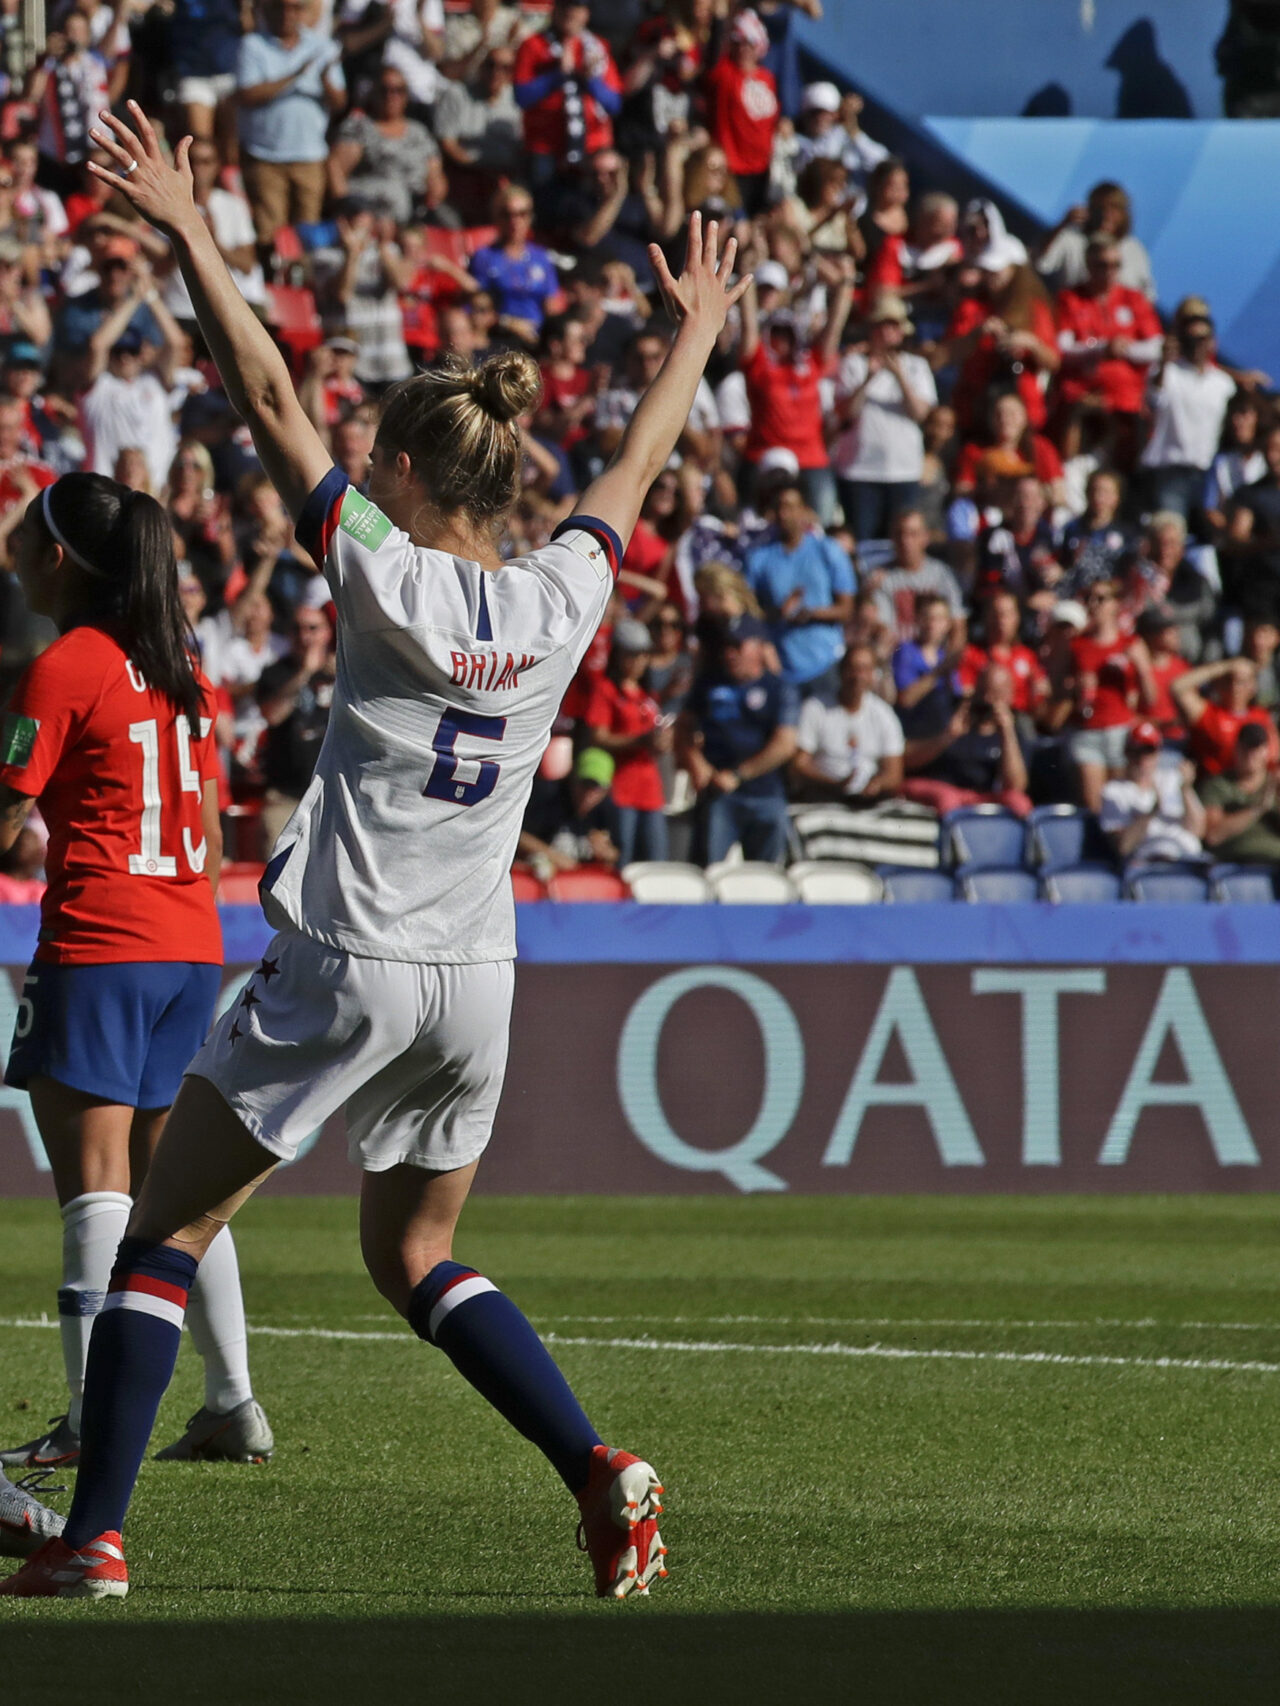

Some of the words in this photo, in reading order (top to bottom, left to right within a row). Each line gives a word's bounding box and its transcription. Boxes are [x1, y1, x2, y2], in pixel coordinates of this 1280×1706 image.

[128, 714, 213, 877] 15
[423, 706, 507, 807] 6
[617, 965, 1261, 1192] QATA
